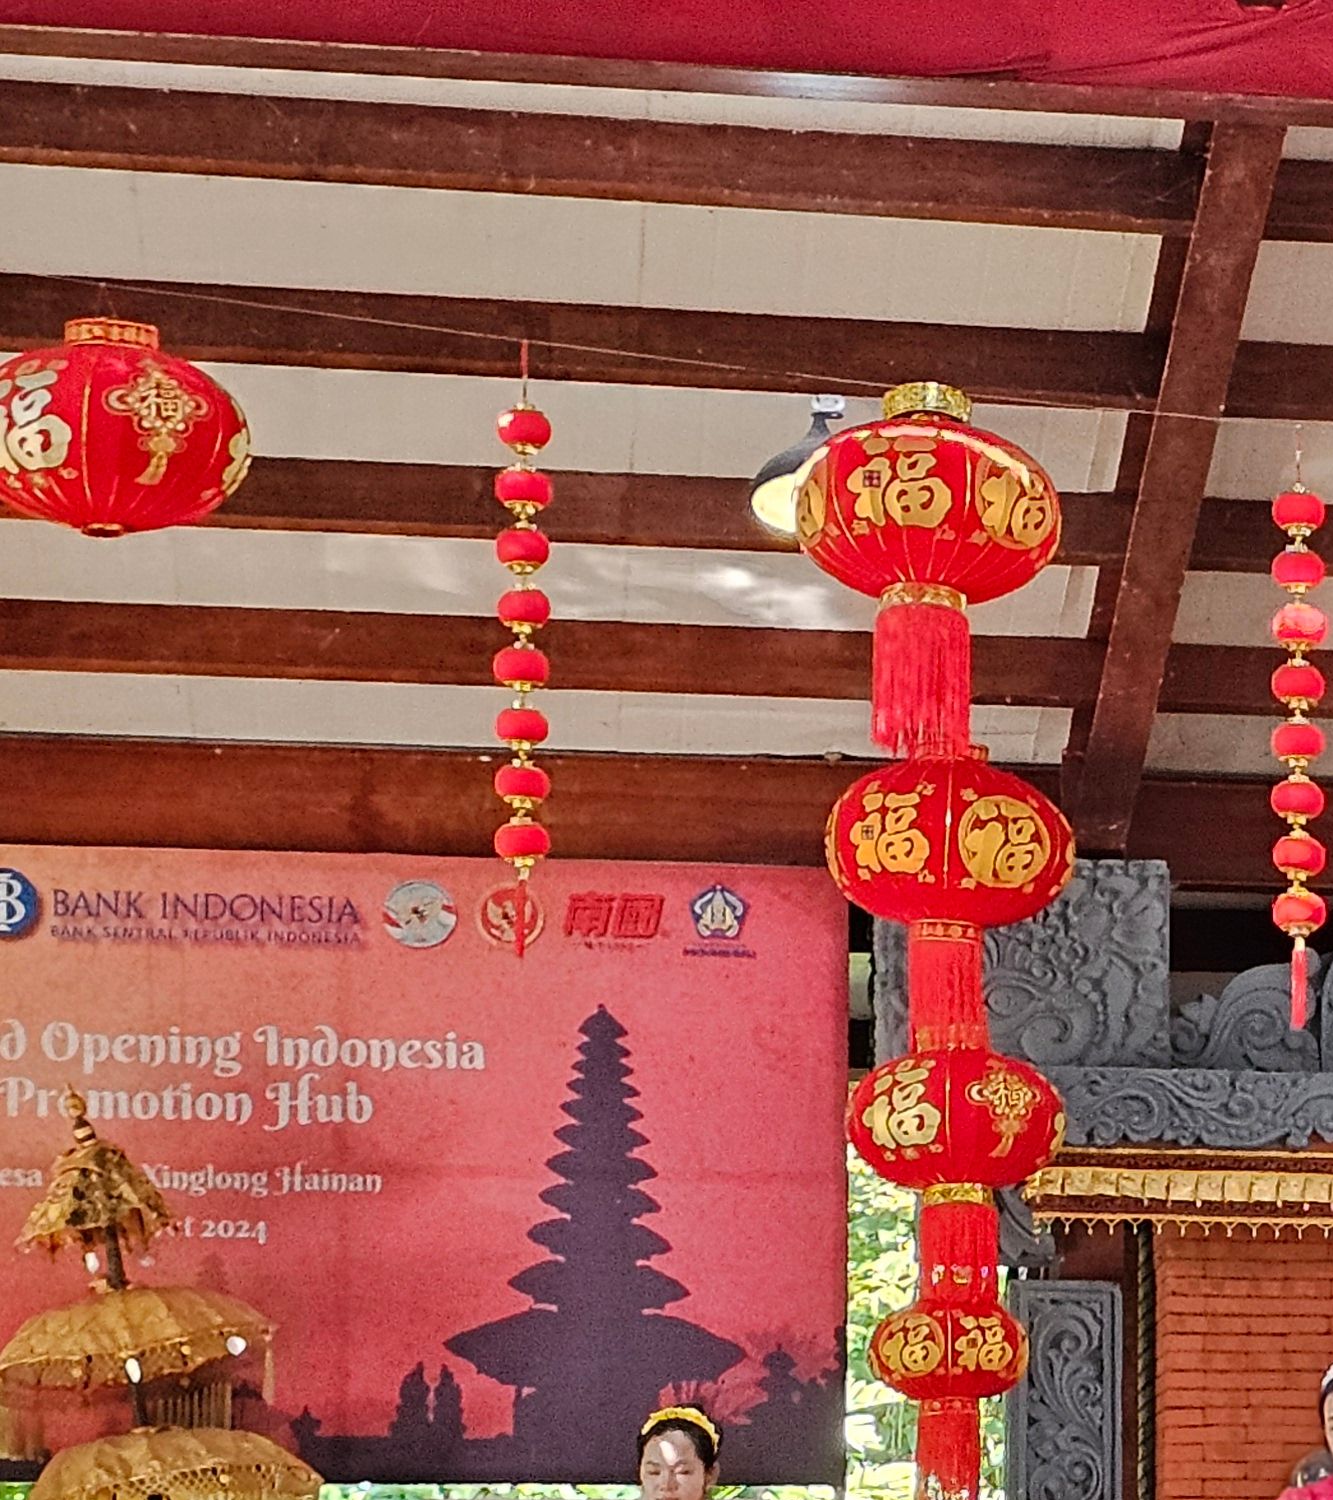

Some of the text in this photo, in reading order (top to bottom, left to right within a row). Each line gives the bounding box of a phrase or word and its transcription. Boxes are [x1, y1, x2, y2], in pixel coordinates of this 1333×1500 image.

[848, 436, 951, 526] 福
[852, 792, 929, 873] 福
[53, 889, 361, 925] BANK INDONESIA
[51, 926, 95, 938] BANK
[268, 930, 361, 945] INDONESIA
[41, 1021, 243, 1077] Opening
[254, 1024, 486, 1072] Indonesia
[264, 1073, 374, 1131] Hub
[863, 1065, 941, 1149] 福
[142, 1163, 268, 1197] Xinglong
[275, 1161, 382, 1195] Hainan
[201, 1219, 268, 1245] 2024
